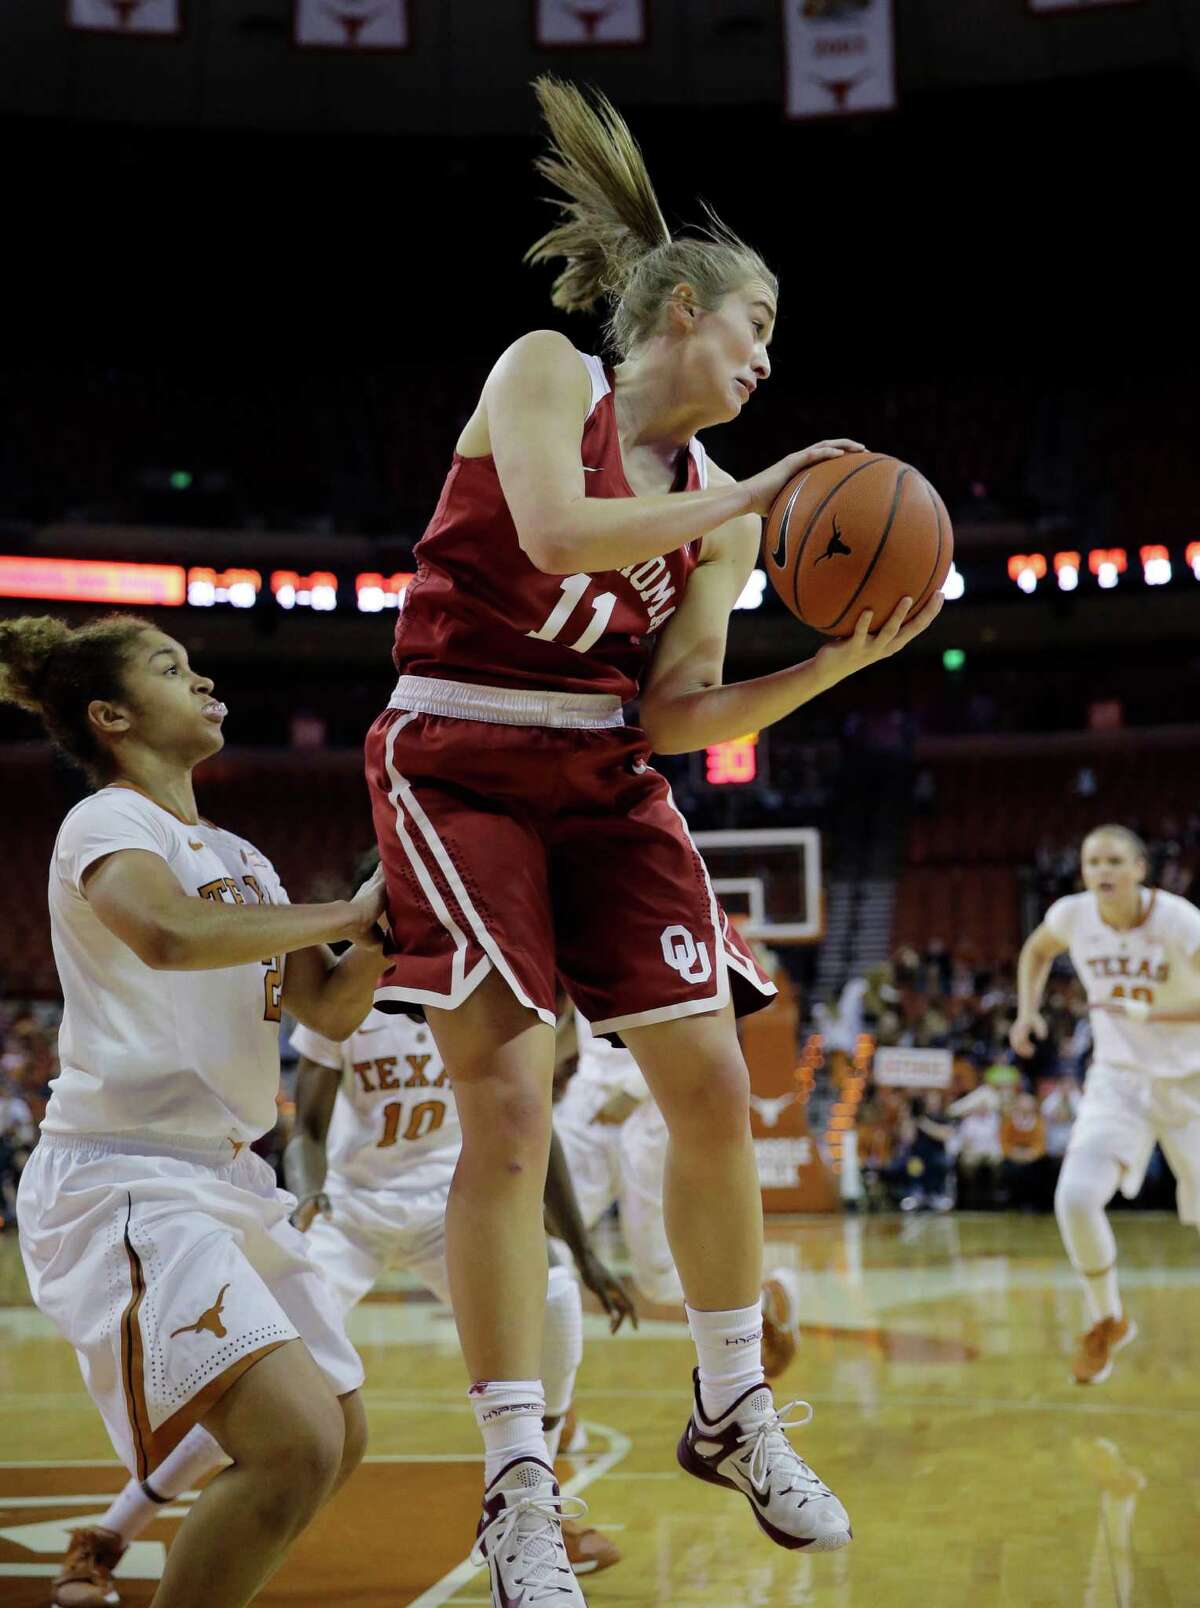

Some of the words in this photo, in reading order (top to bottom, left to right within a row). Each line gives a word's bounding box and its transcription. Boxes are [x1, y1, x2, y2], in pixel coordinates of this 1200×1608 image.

[525, 573, 618, 653] 11
[660, 925, 712, 984] OU
[1087, 957, 1169, 983] TEXAS
[376, 1101, 446, 1148] 10
